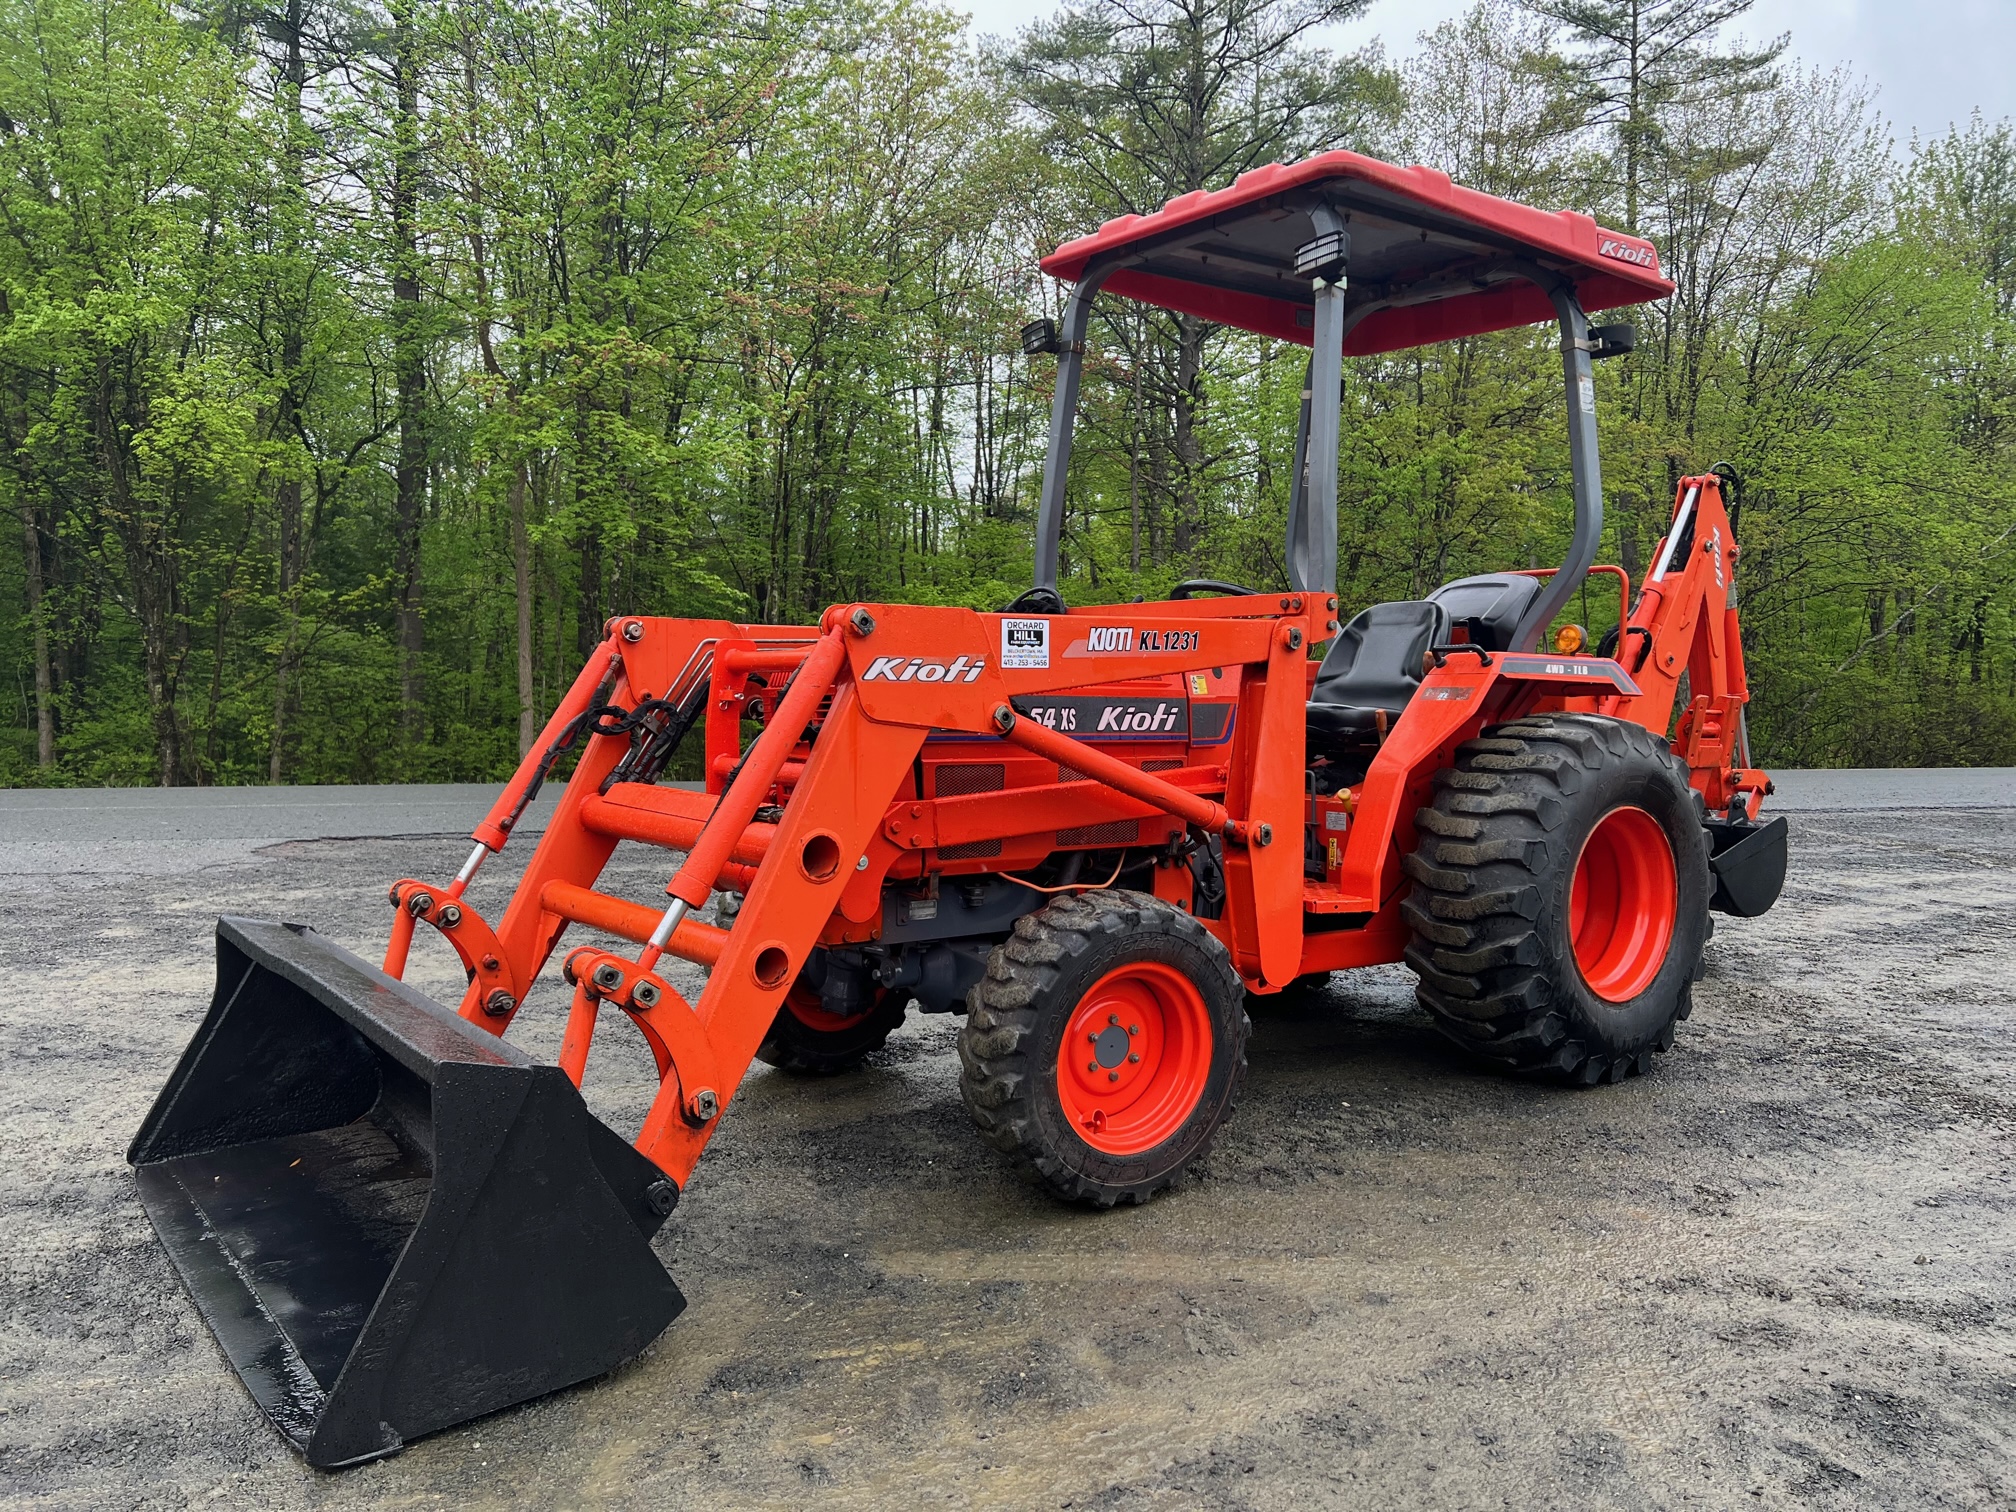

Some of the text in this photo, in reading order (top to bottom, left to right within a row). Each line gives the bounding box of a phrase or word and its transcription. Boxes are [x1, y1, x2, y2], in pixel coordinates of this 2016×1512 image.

[1600, 240, 1653, 267] Kioti
[1713, 526, 1723, 588] Kioti
[1014, 630, 1036, 640] HILL
[1087, 627, 1199, 652] KIOTI KL1231
[861, 655, 986, 683] Kioti
[1545, 664, 1565, 674] 4WD
[1573, 665, 1588, 675] TLB
[1060, 708, 1077, 731] XS
[1096, 702, 1179, 732] Kioti
